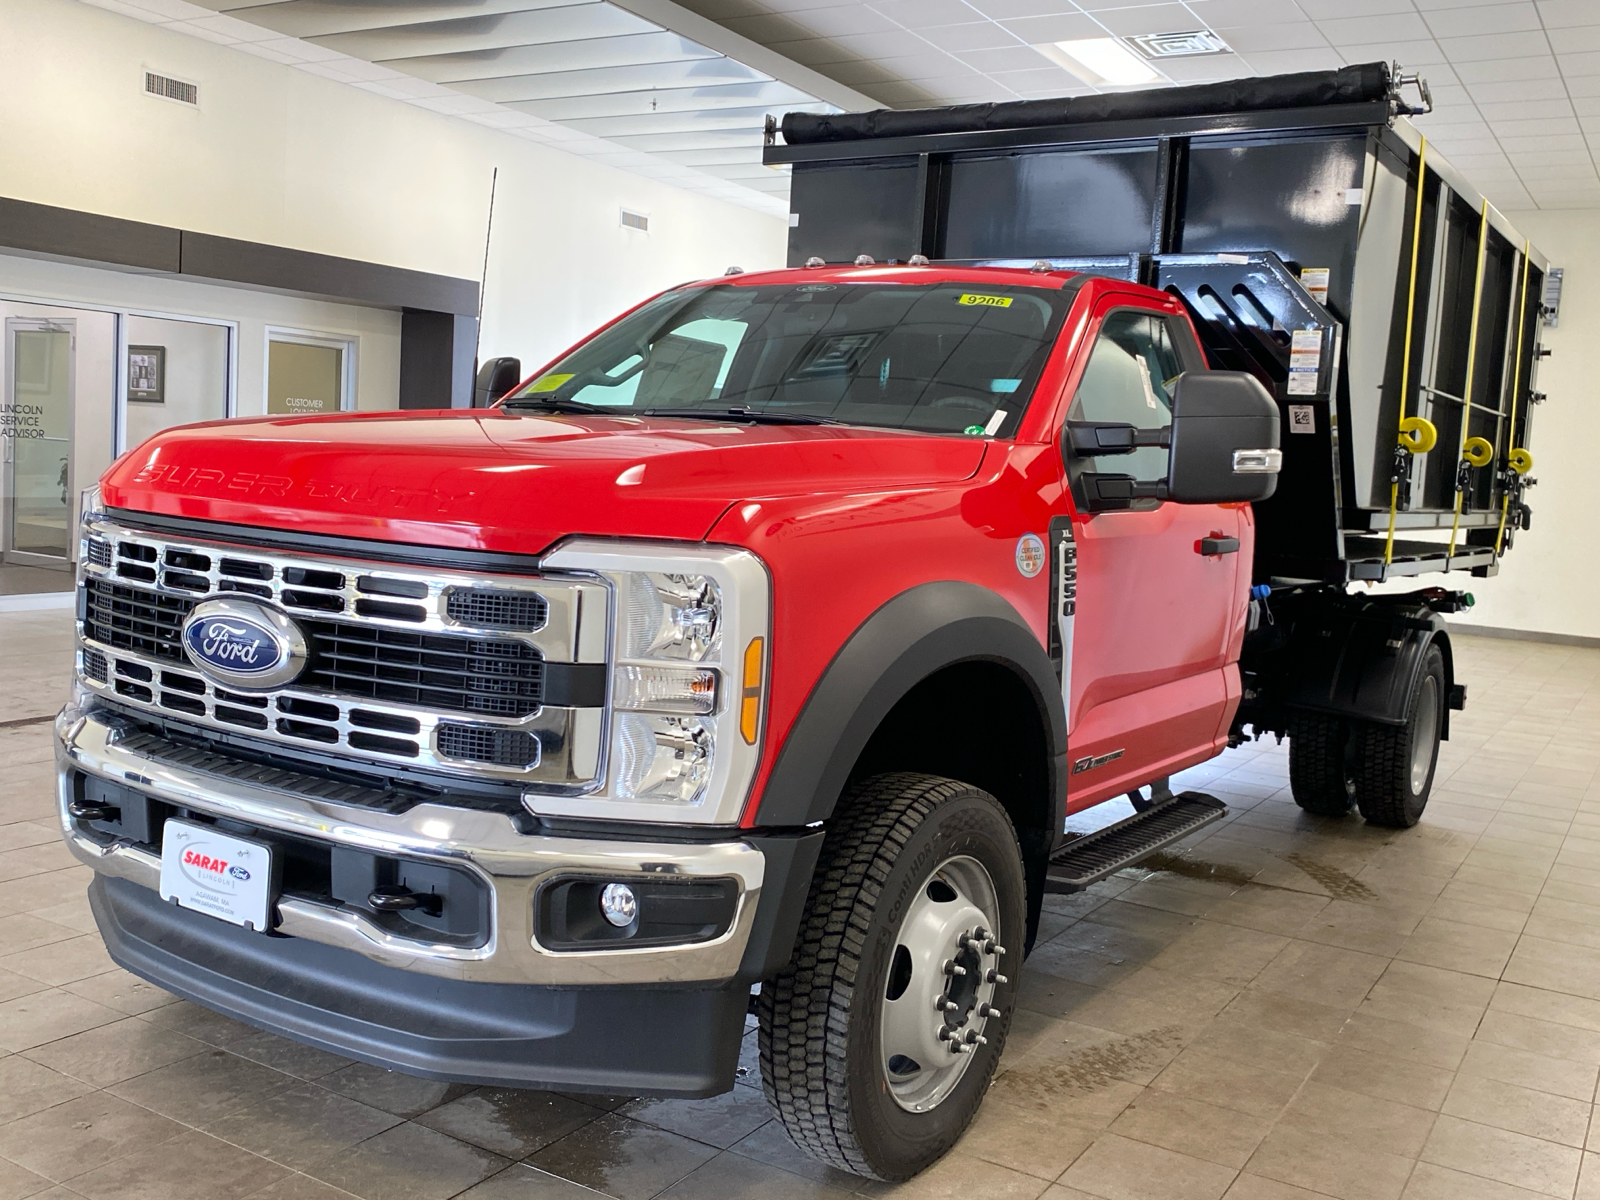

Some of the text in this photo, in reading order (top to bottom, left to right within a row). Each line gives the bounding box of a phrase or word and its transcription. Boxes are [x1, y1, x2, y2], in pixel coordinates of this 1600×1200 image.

[967, 295, 1006, 306] 9206
[285, 397, 324, 408] CUSTOMER
[0, 403, 43, 415] LINCOLN
[0, 415, 40, 427] SERVICE
[1, 427, 45, 439] ADVISOR
[133, 463, 477, 513] SUPER DUTY
[1062, 529, 1072, 538] XL
[203, 622, 260, 664] Ford
[184, 850, 248, 880] SARAT Ford
[202, 873, 230, 885] LINCOLN
[888, 874, 913, 924] Conti
[911, 842, 932, 877] HDR
[220, 898, 230, 907] MA
